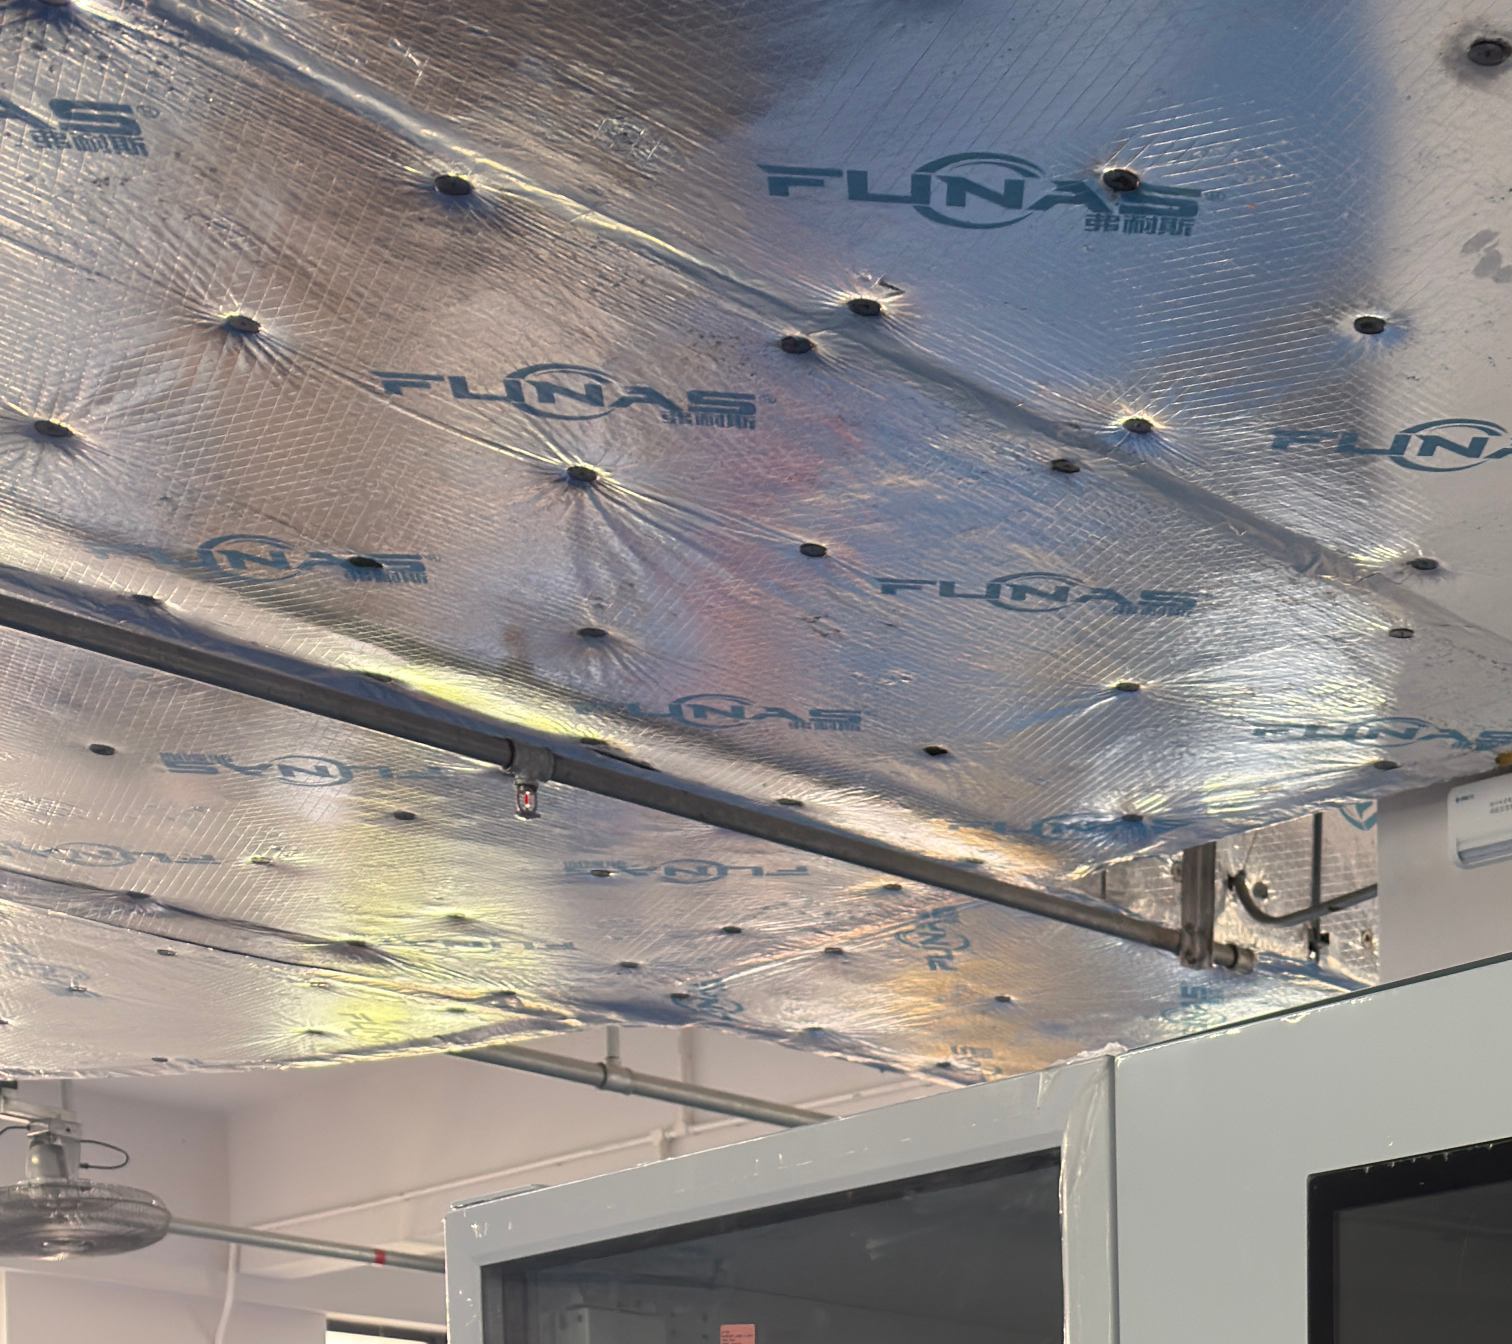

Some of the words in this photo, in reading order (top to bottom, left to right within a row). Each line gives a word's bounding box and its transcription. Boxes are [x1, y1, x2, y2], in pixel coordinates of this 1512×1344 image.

[758, 157, 1201, 224] FUNAS
[1084, 212, 1194, 236] 弗耐斯
[368, 367, 756, 418] FUNAS
[873, 574, 1199, 610] FUNAS
